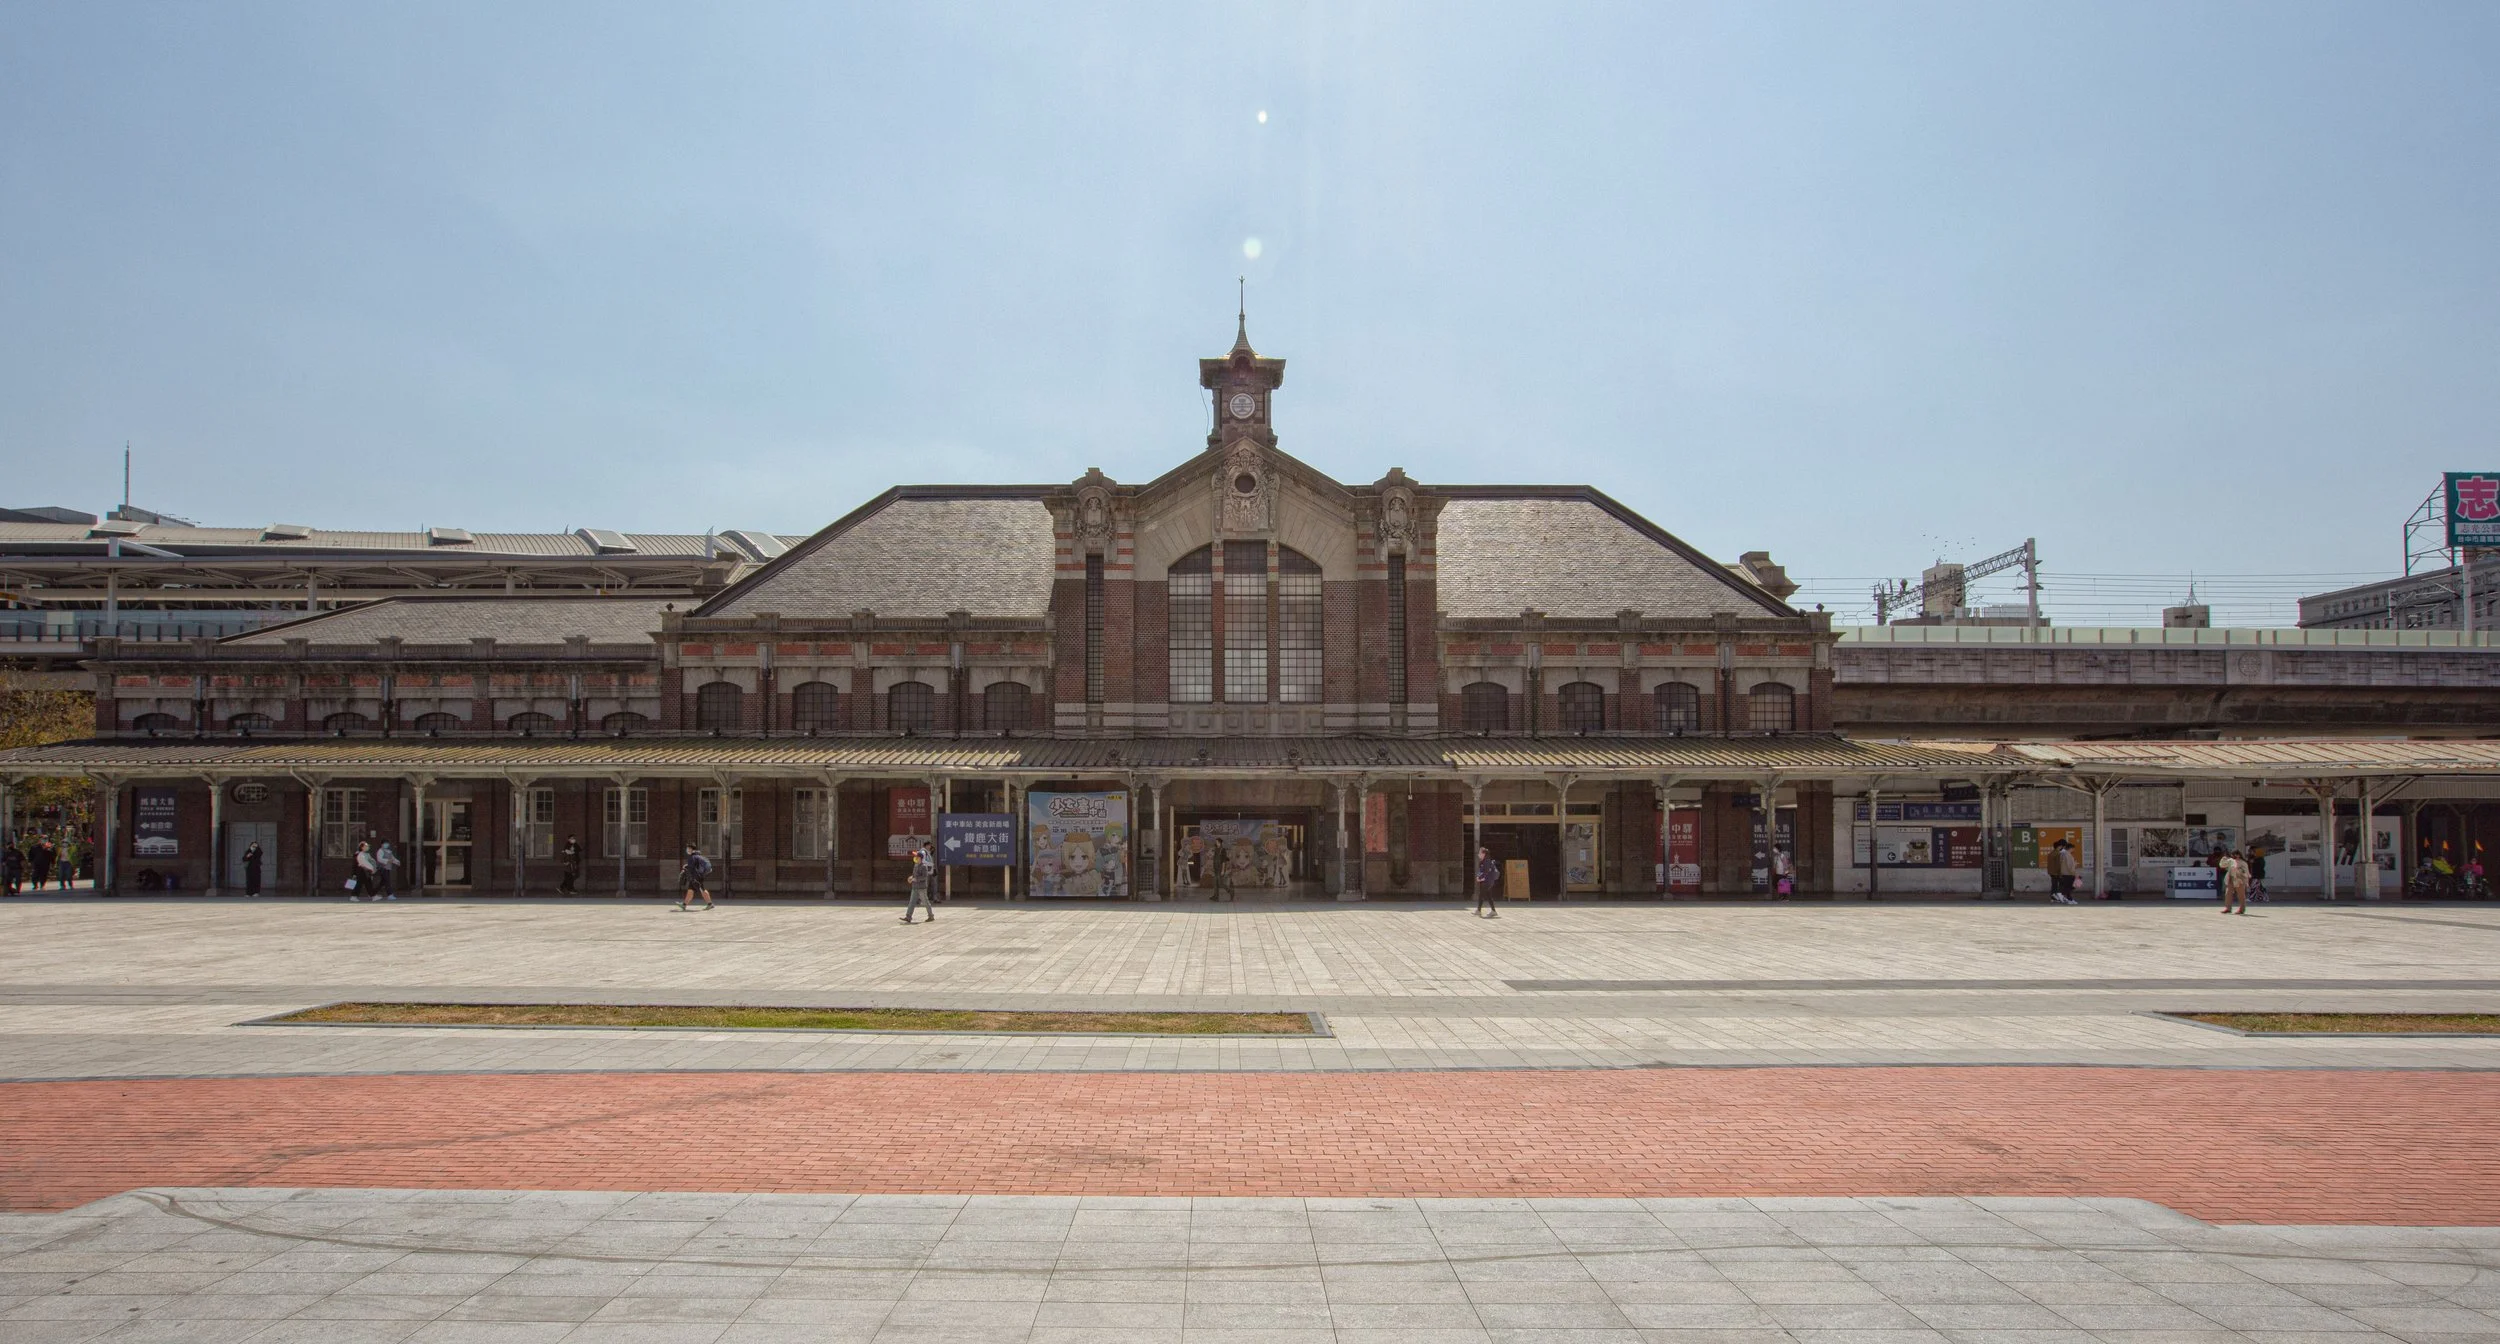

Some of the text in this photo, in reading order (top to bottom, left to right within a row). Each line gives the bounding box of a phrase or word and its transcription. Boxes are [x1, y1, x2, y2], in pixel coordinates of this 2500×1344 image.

[2456, 476, 2500, 520] 志
[964, 832, 1009, 844] 鐵鹿大街
